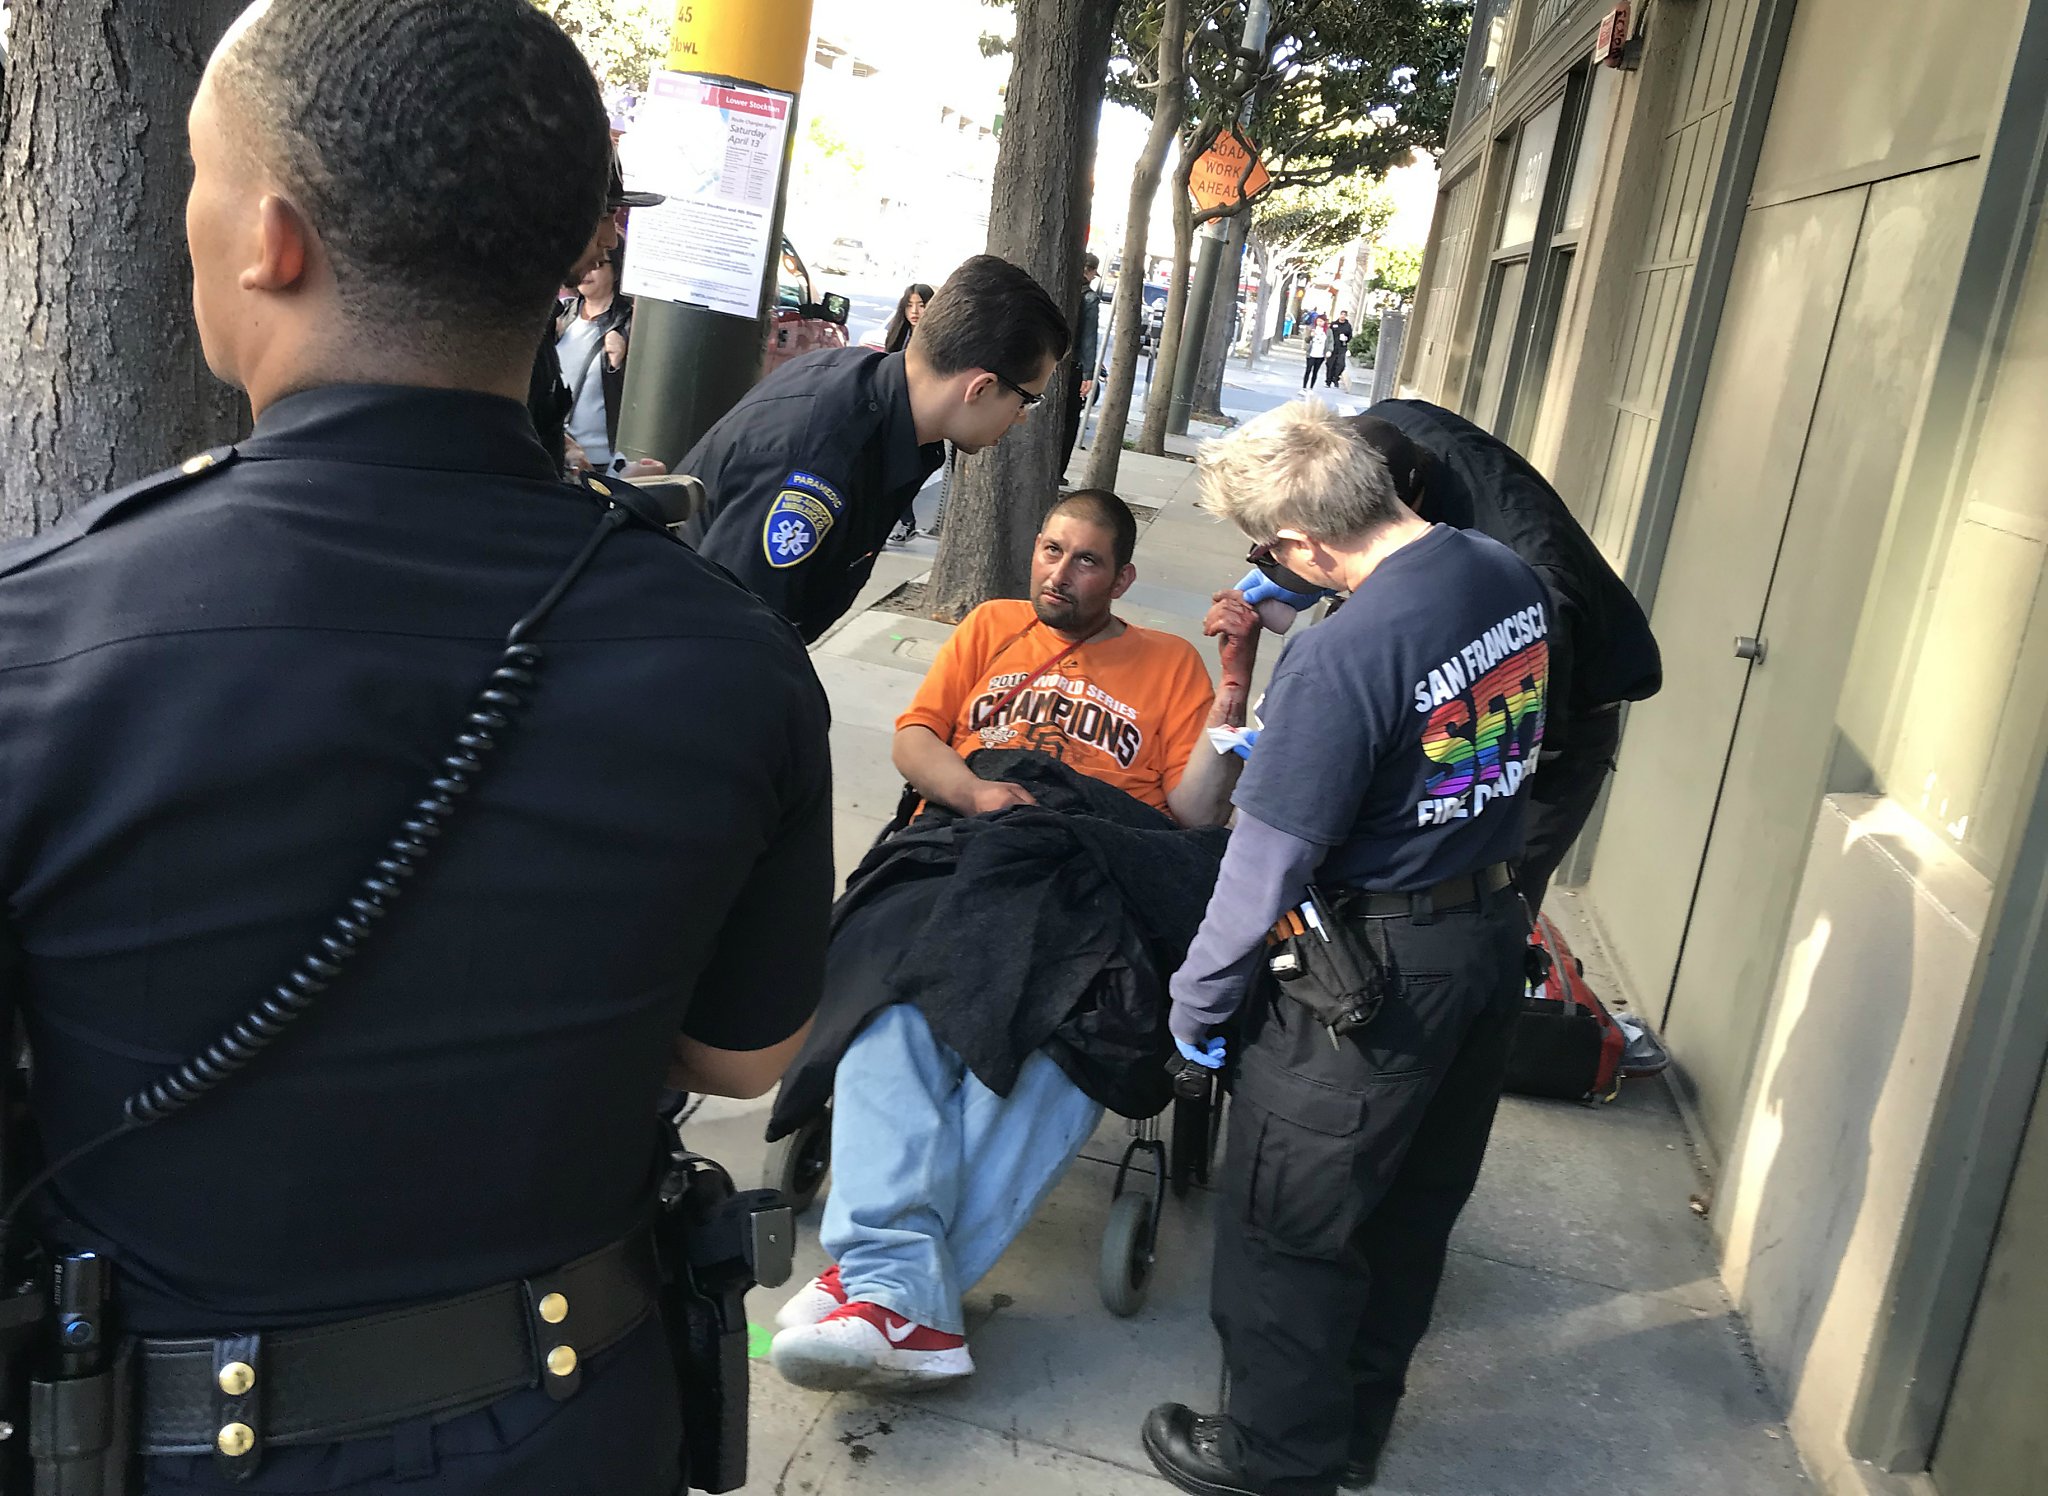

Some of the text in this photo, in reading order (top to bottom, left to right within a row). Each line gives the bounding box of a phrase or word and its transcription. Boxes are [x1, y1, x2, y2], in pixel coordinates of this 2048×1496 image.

[678, 6, 693, 23] 45
[725, 96, 780, 113] Lower Stockton
[730, 124, 767, 139] Saturday
[728, 134, 761, 148] April 13
[1206, 161, 1241, 178] WORK
[1197, 180, 1240, 198] AHEAD
[793, 475, 843, 509] PARAMEDIC
[1414, 602, 1548, 713] SAN FRANCISC
[1033, 673, 1085, 696] WORLD
[1086, 684, 1138, 721] SERIES
[969, 688, 1143, 770] CHAMPIONS
